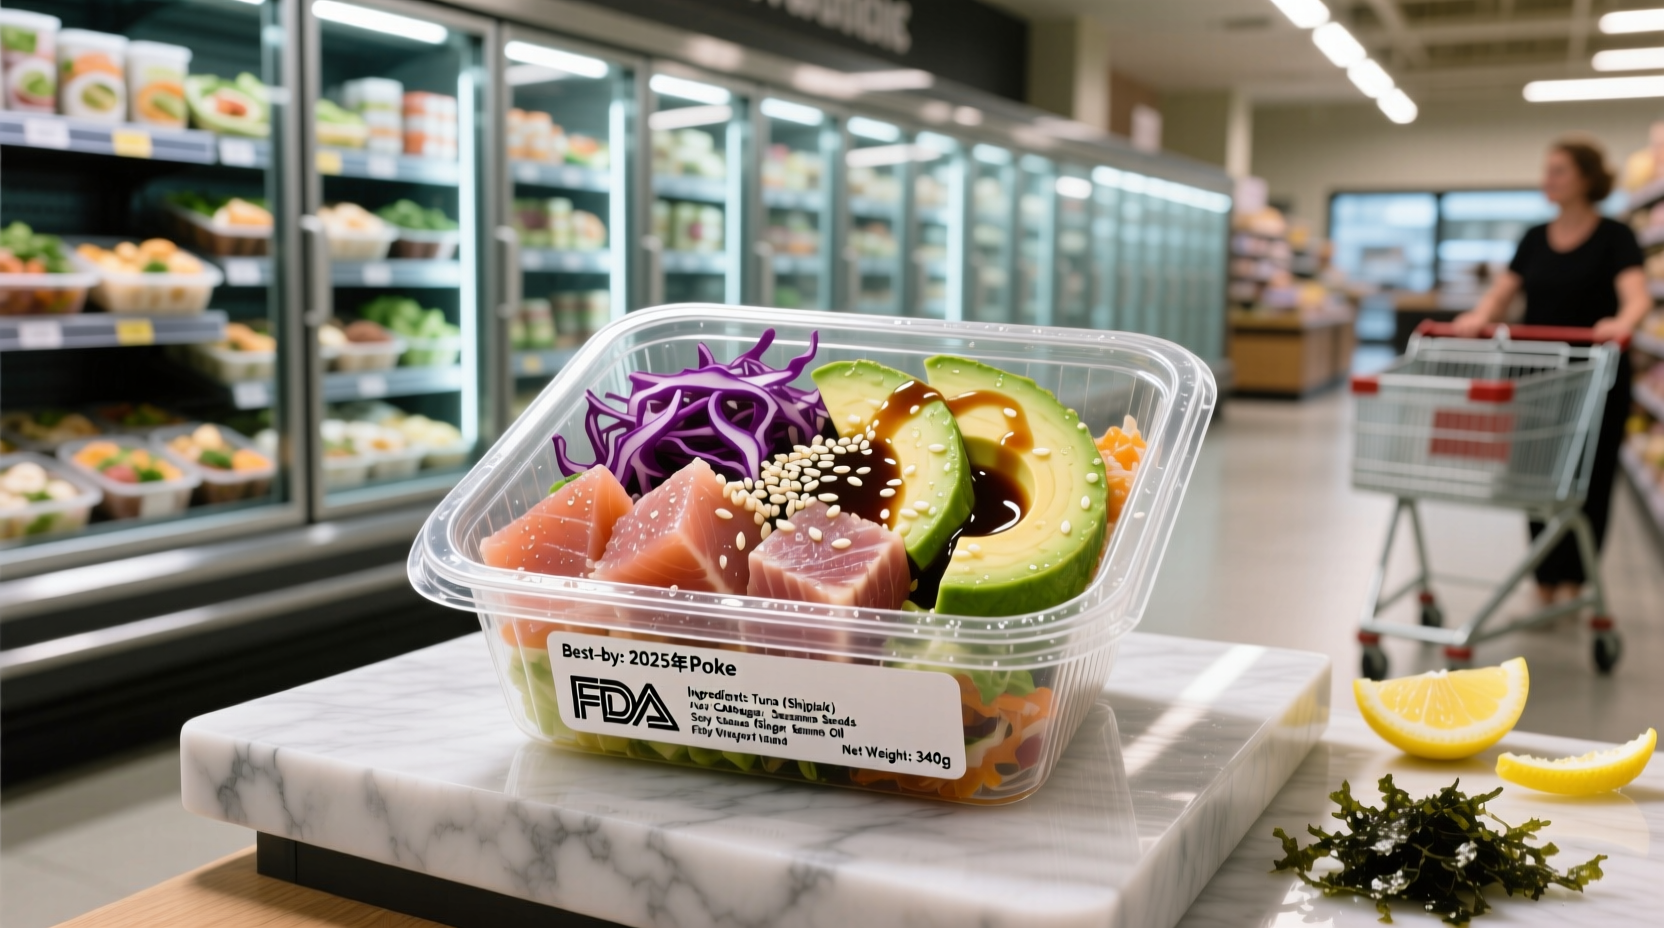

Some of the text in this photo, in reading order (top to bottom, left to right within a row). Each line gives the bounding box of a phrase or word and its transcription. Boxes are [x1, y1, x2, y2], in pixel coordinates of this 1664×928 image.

[562, 643, 625, 667] Best-by:
[570, 675, 680, 732] FDA
[751, 693, 779, 706] Tuna
[842, 744, 951, 769] Net Weight: 340g
